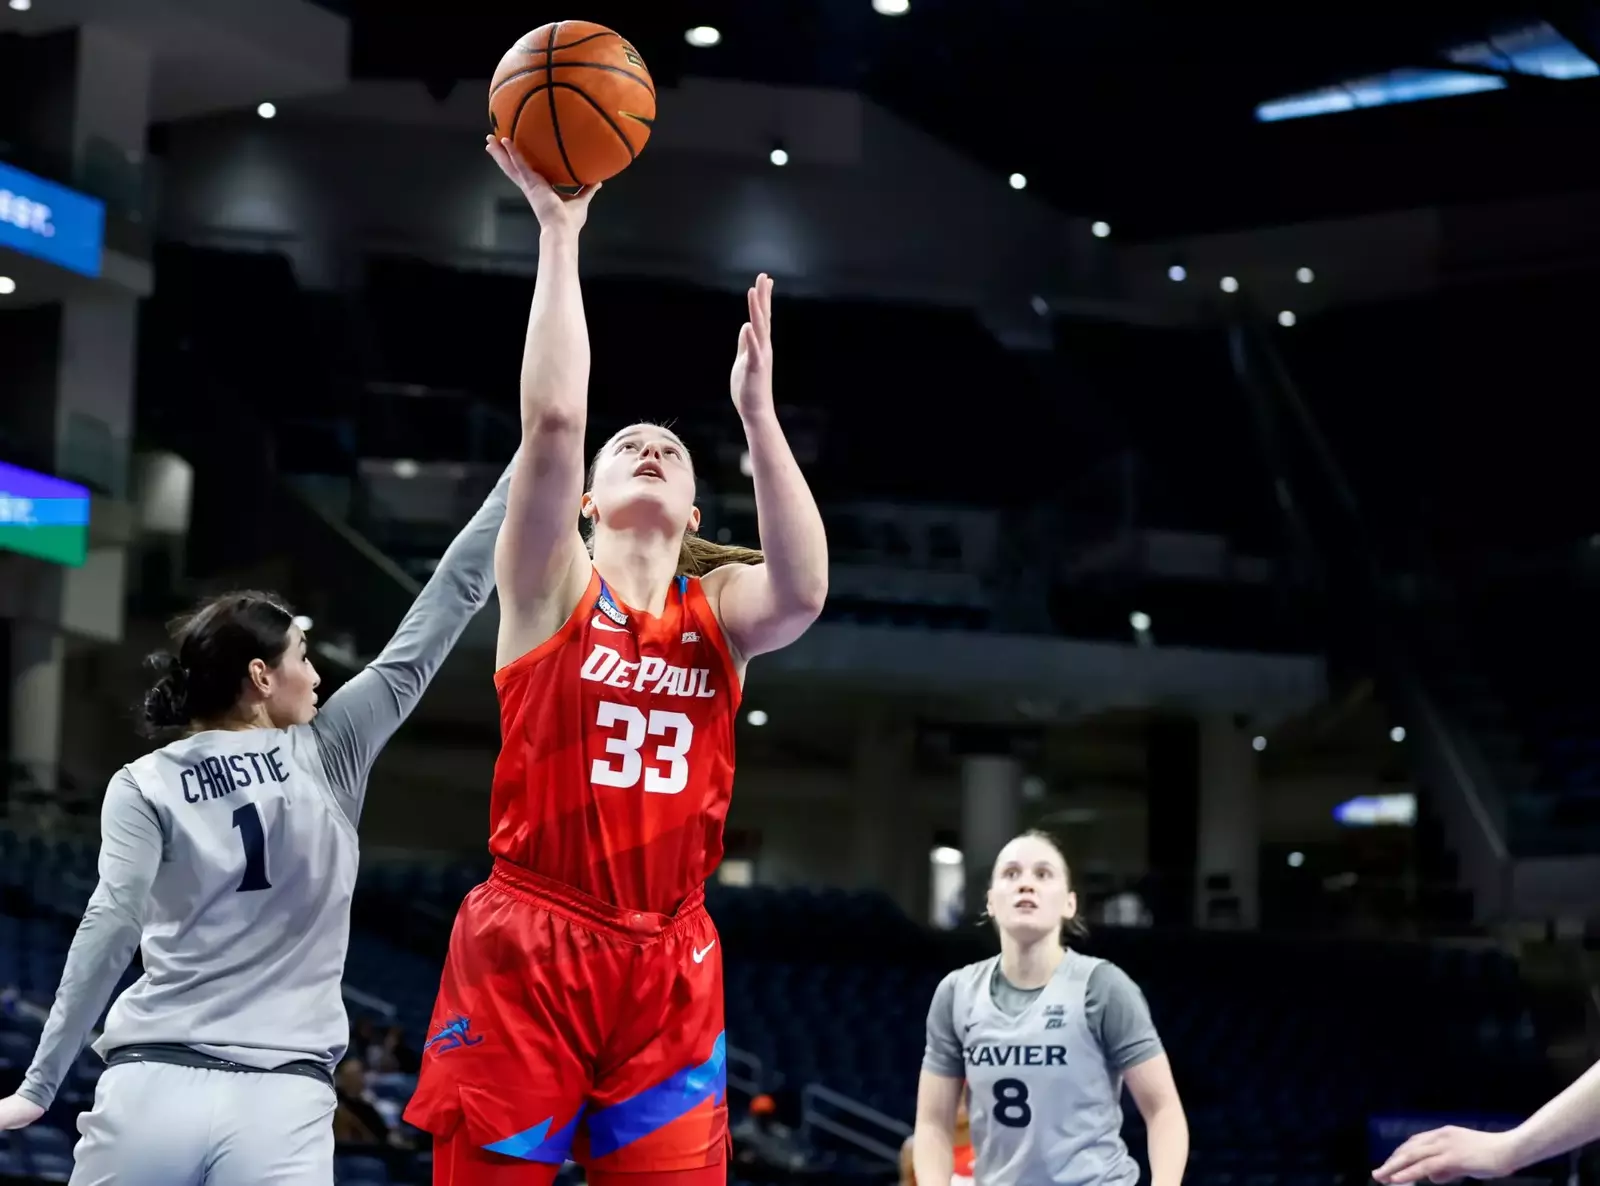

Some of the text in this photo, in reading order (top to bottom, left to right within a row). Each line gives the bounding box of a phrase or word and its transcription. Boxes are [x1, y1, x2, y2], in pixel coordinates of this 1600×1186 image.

[580, 643, 716, 698] DEPAUL
[179, 746, 290, 804] CHRISTIE
[590, 700, 694, 794] 33
[232, 802, 272, 892] 1
[963, 1045, 1068, 1066] XAVIER
[992, 1077, 1032, 1128] 8
